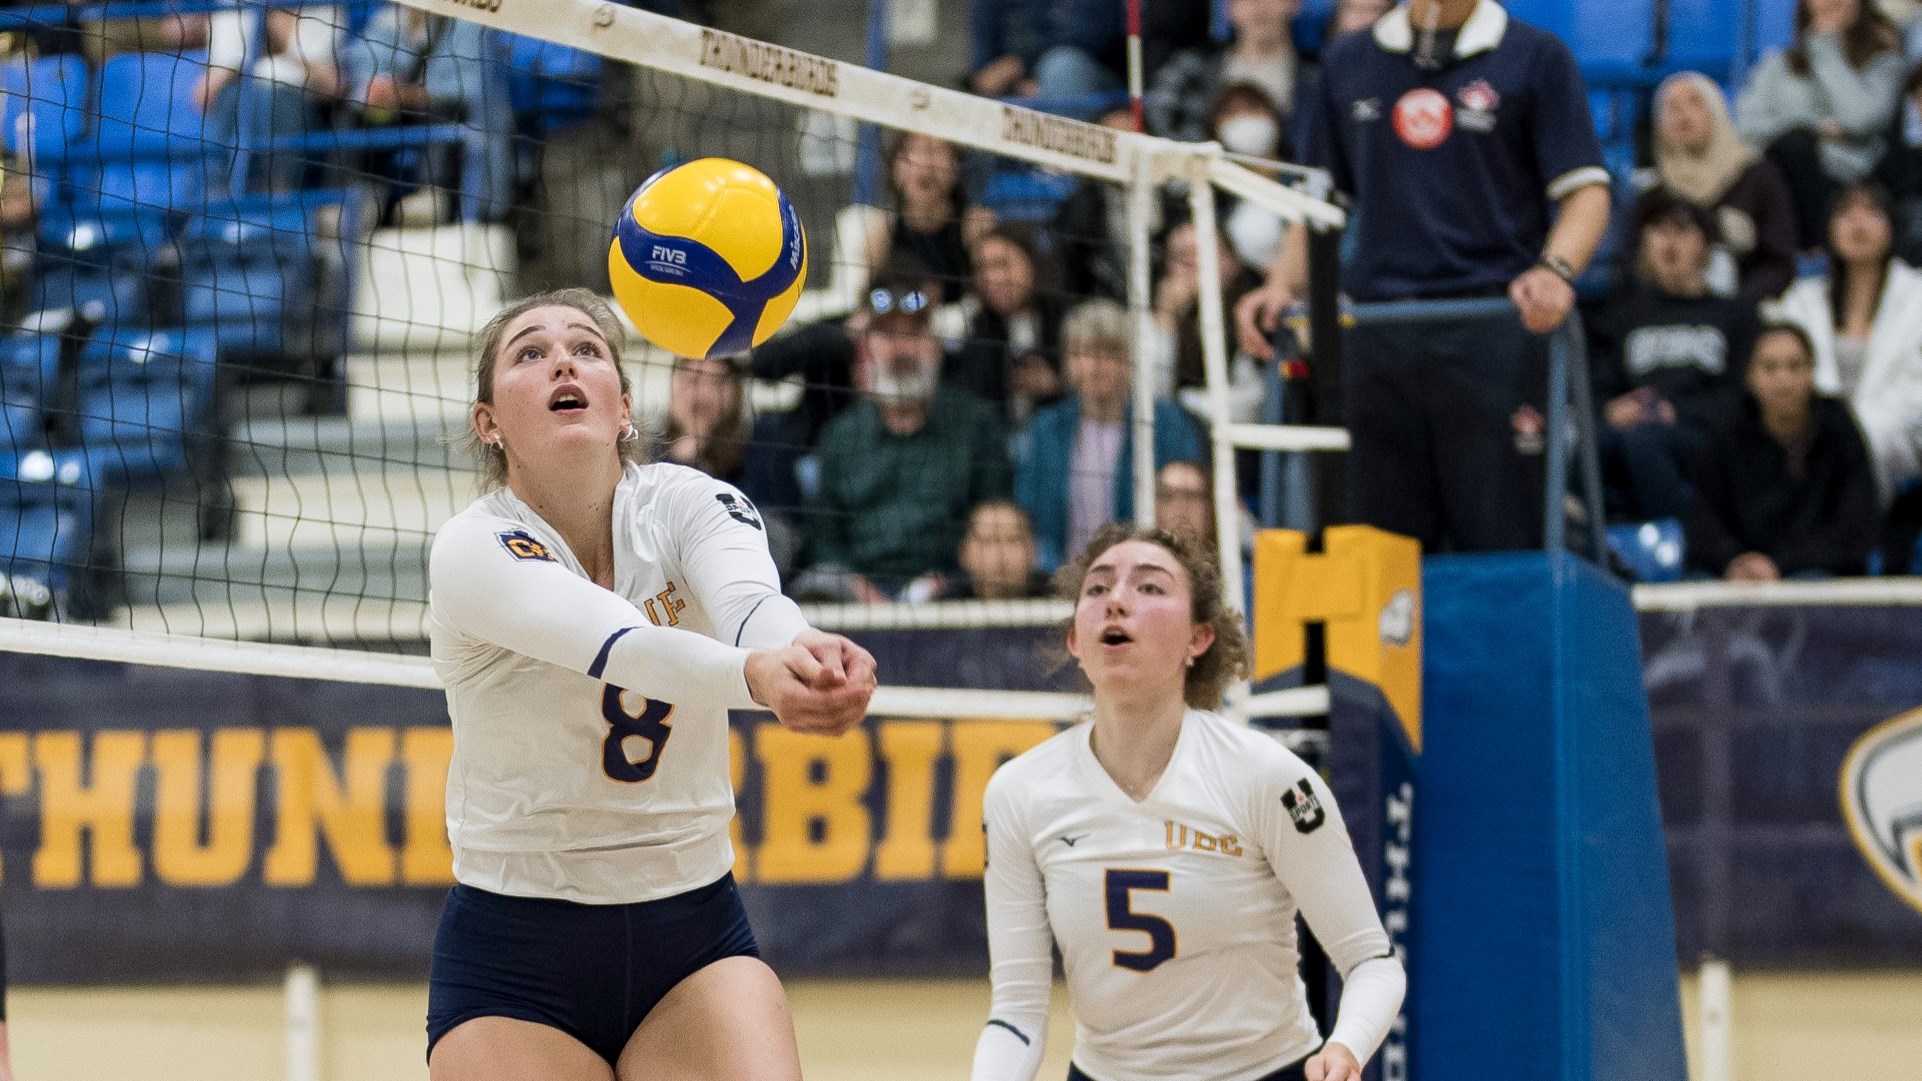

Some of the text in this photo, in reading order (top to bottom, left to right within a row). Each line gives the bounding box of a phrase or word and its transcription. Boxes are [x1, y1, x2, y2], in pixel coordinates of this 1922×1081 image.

[651, 244, 688, 265] FIVB
[600, 681, 675, 785] 8
[1103, 866, 1178, 975] 5
